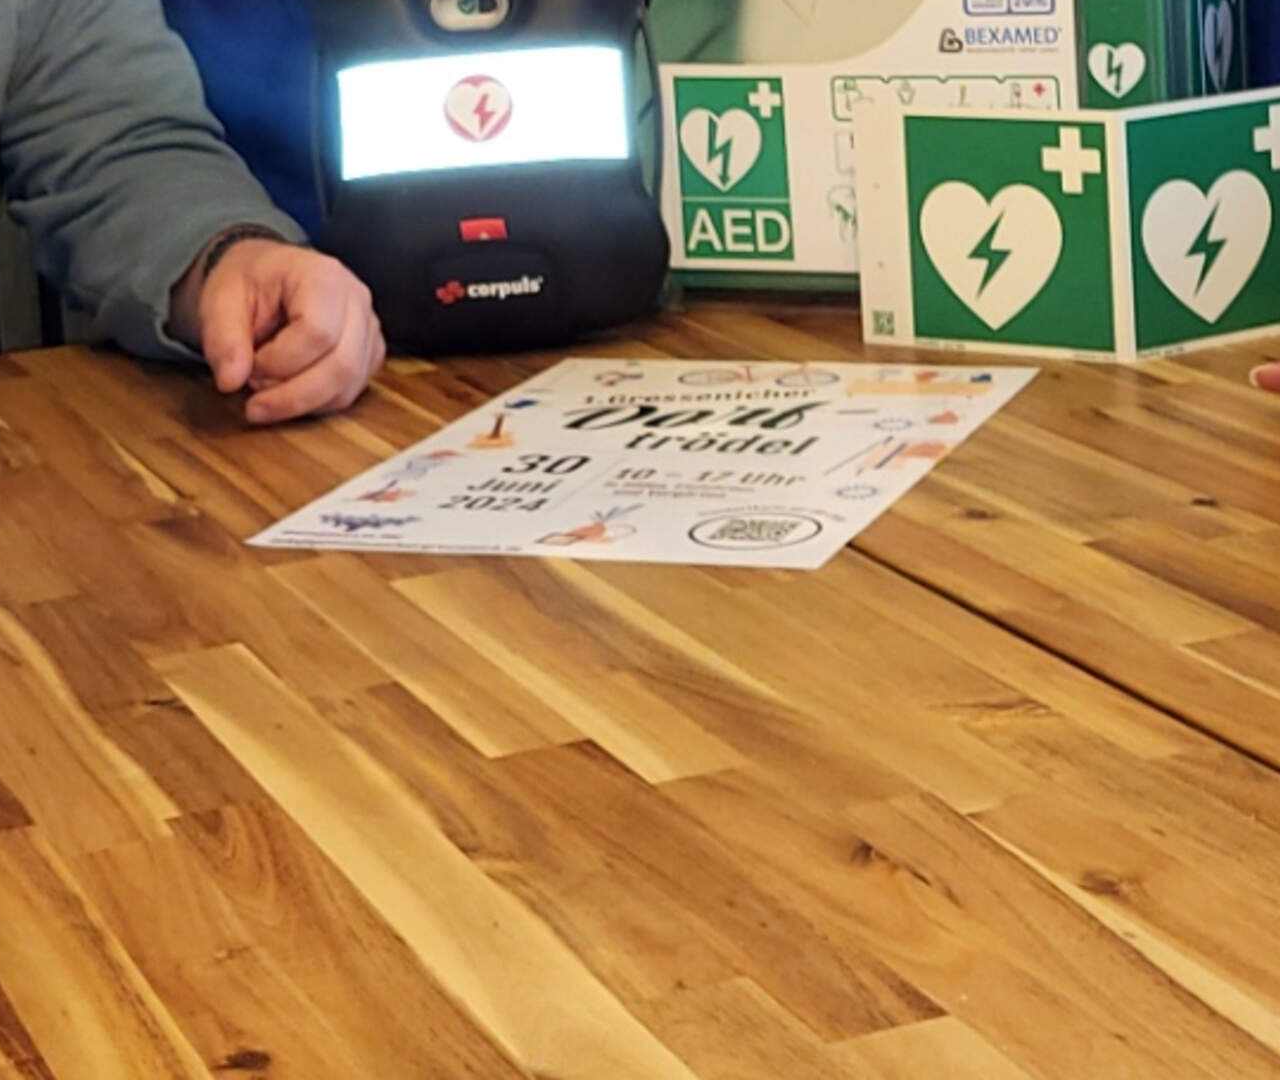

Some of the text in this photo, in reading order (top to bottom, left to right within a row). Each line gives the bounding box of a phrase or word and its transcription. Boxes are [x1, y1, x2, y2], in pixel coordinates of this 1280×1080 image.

[964, 26, 1059, 46] BEXAMED
[688, 208, 790, 252] AED
[467, 275, 541, 300] corpuls
[625, 431, 819, 456] trödel
[502, 454, 591, 476] 30
[466, 477, 563, 494] Juni
[616, 467, 651, 481] 10
[697, 469, 727, 484] 17
[741, 471, 806, 487] Uhr
[438, 494, 550, 513] 2024
